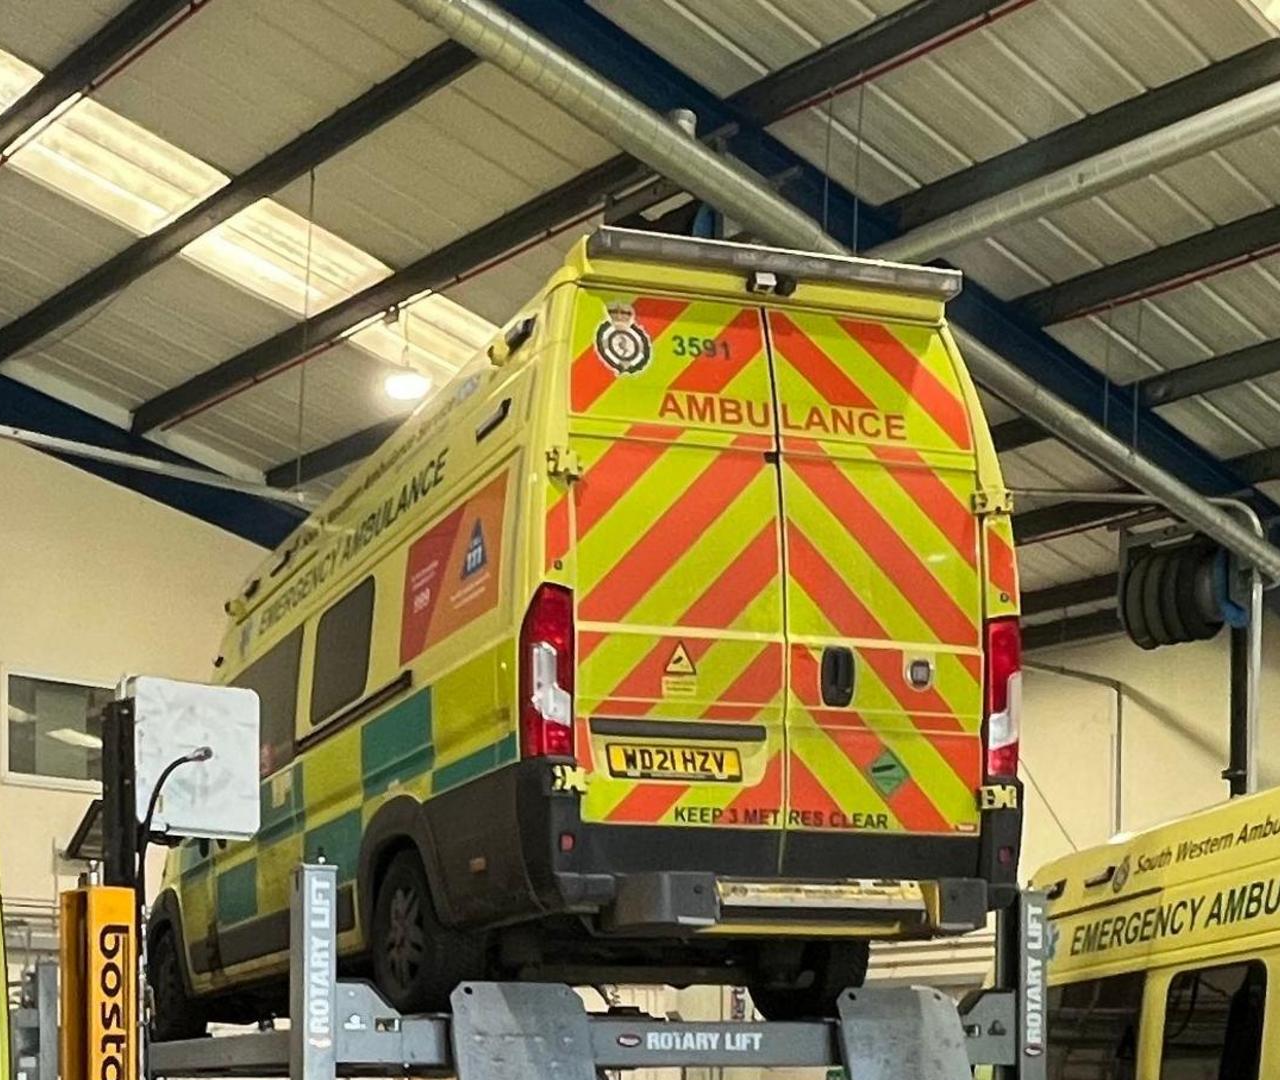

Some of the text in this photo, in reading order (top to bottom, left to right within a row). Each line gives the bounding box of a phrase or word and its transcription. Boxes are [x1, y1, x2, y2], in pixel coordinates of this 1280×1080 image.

[672, 335, 730, 361] 3591
[658, 393, 907, 440] AMBULANCE
[338, 447, 449, 566] AMBULANCE
[623, 747, 725, 774] WD21 HZV
[674, 807, 889, 829] KEEP 3 METRES CLEAR
[1133, 845, 1173, 875] South
[1174, 829, 1235, 862] Western
[1070, 896, 1206, 956] EMERGENCY
[309, 877, 331, 1034] ROTARY LIFT
[1026, 904, 1043, 1044] ROTARY LIFT
[646, 1031, 763, 1051] ROTARY LIFT
